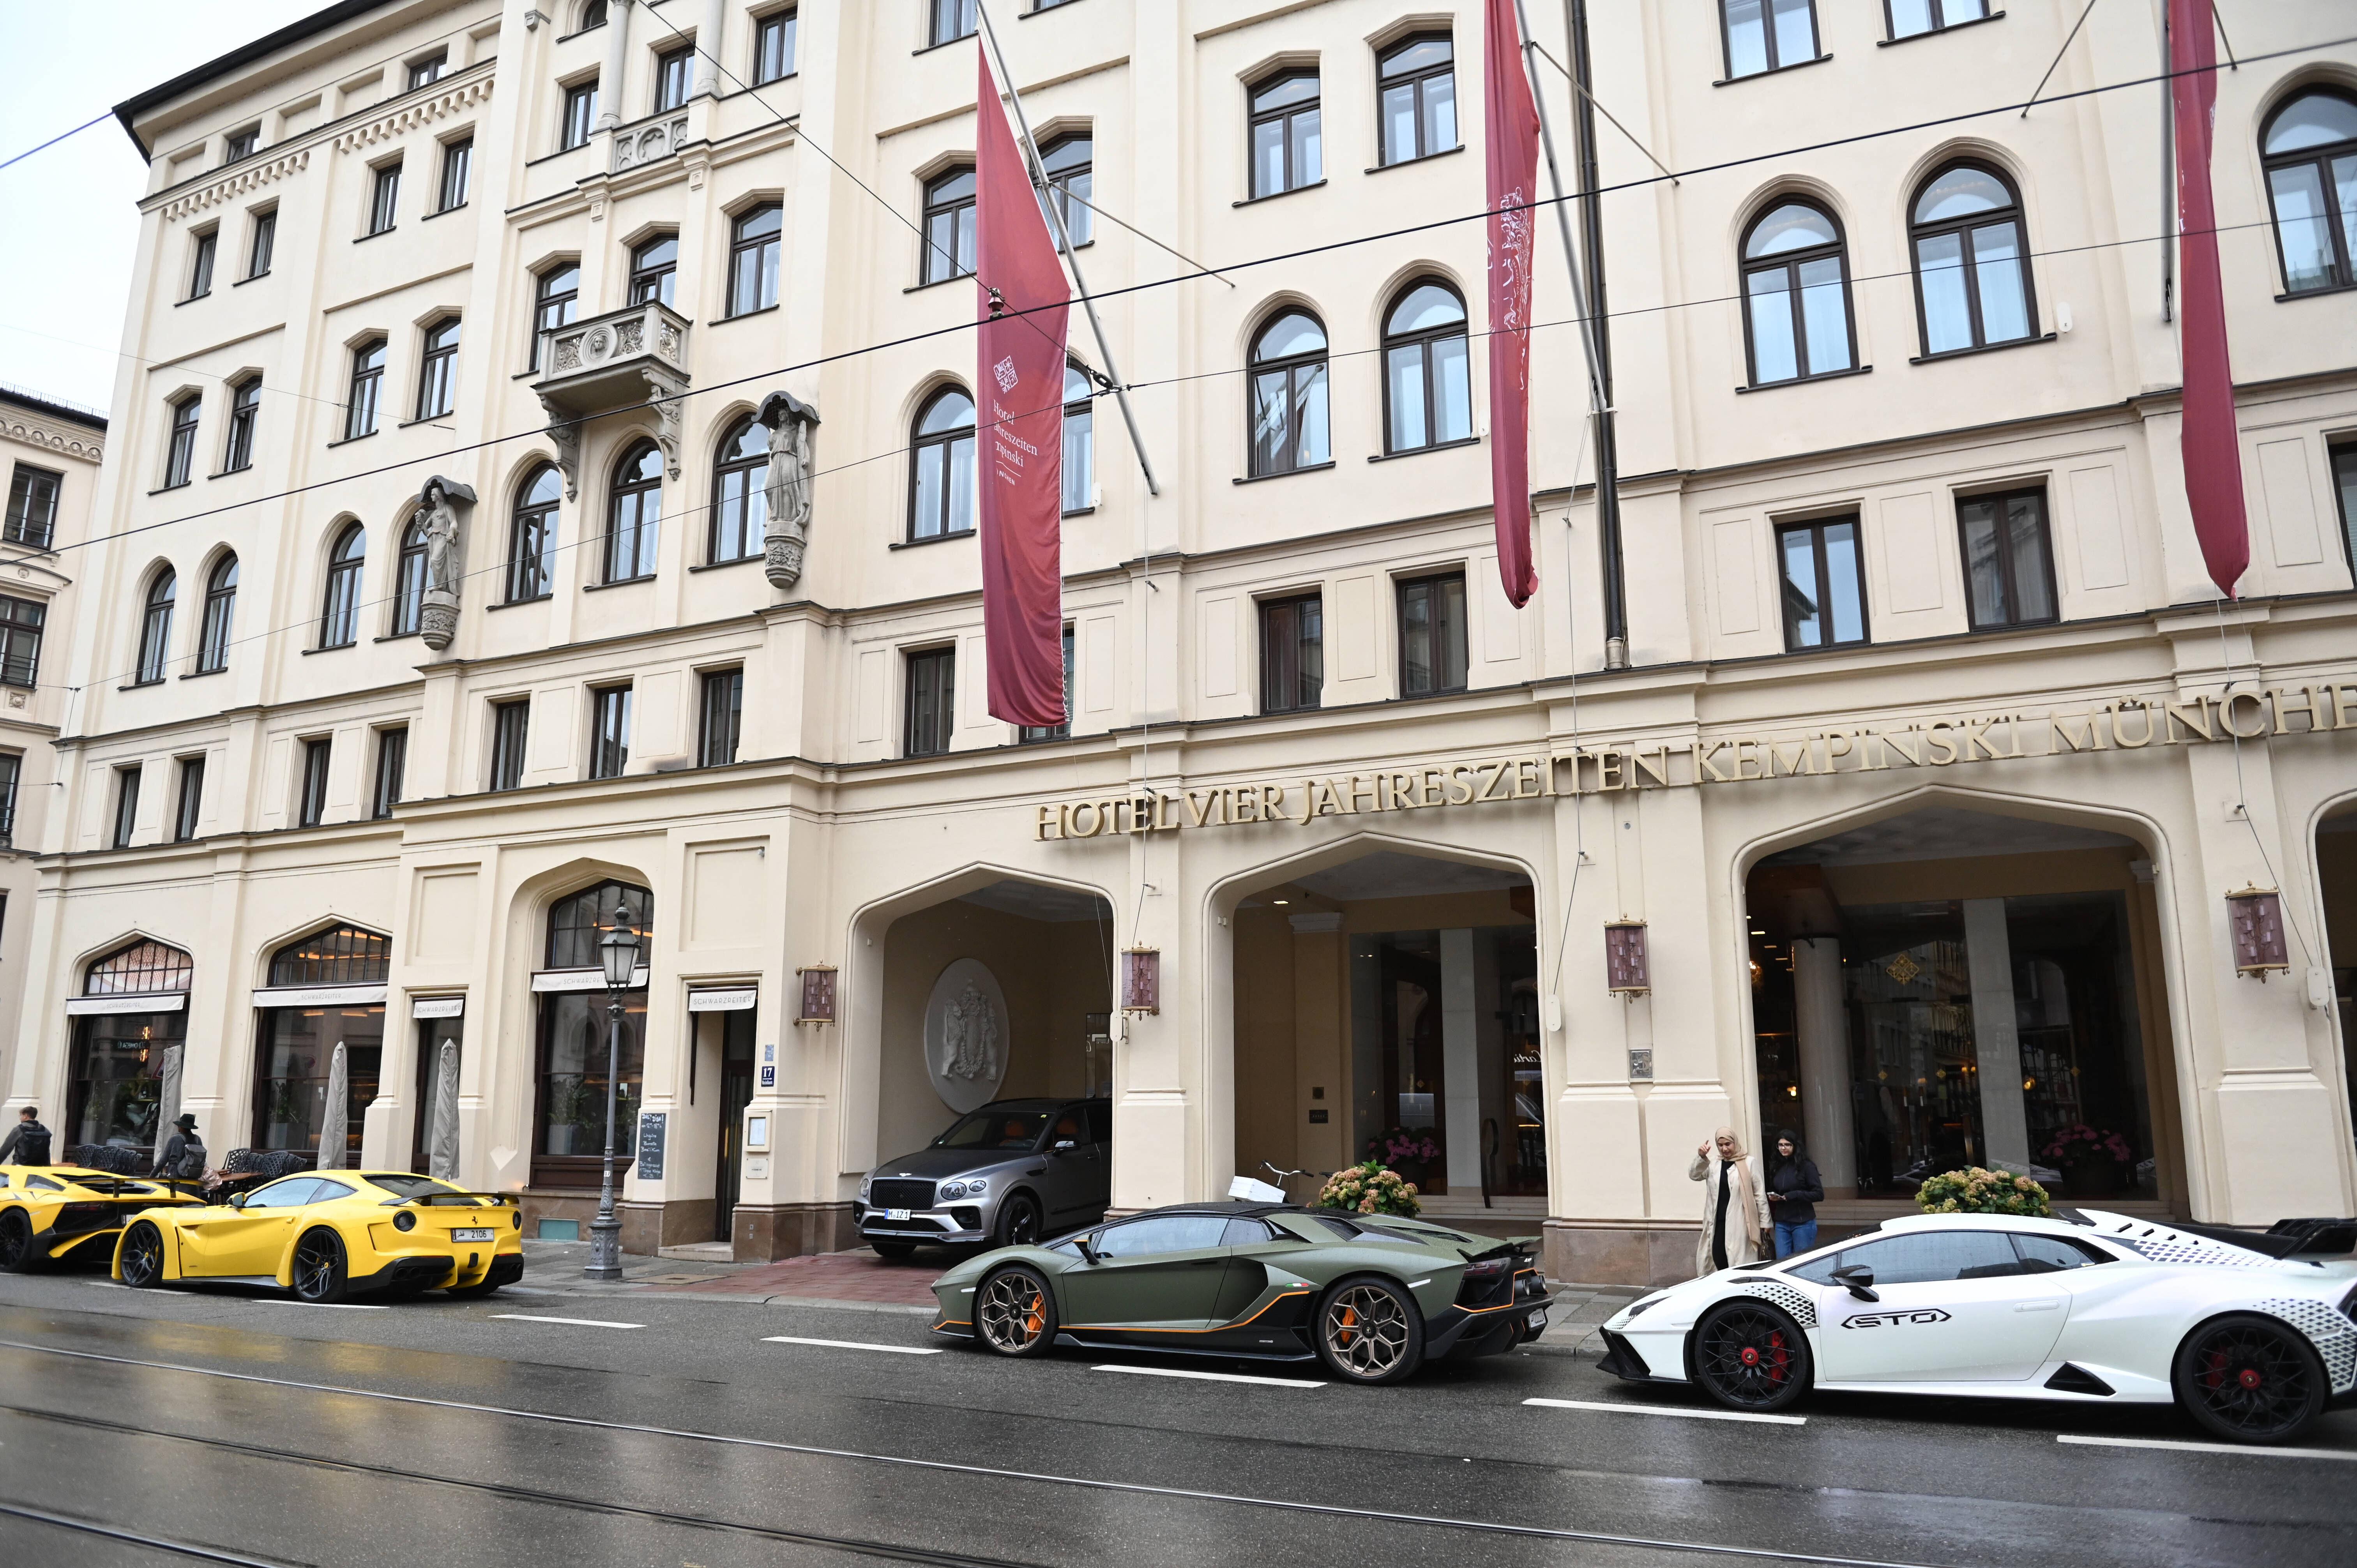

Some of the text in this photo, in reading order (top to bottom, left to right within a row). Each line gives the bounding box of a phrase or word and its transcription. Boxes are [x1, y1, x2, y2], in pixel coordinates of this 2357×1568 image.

[993, 399, 1014, 425] Hotel
[1034, 796, 1181, 841] HOTEL
[1183, 784, 1288, 828] VIER
[1298, 744, 1669, 826] JAHRESZEITEN
[1689, 713, 2024, 785] KEMPINSKI
[693, 996, 752, 1005] SCHWARZREITER
[763, 1067, 772, 1077] 17
[471, 1230, 487, 1238] 2106
[1855, 1312, 1937, 1328] STO
